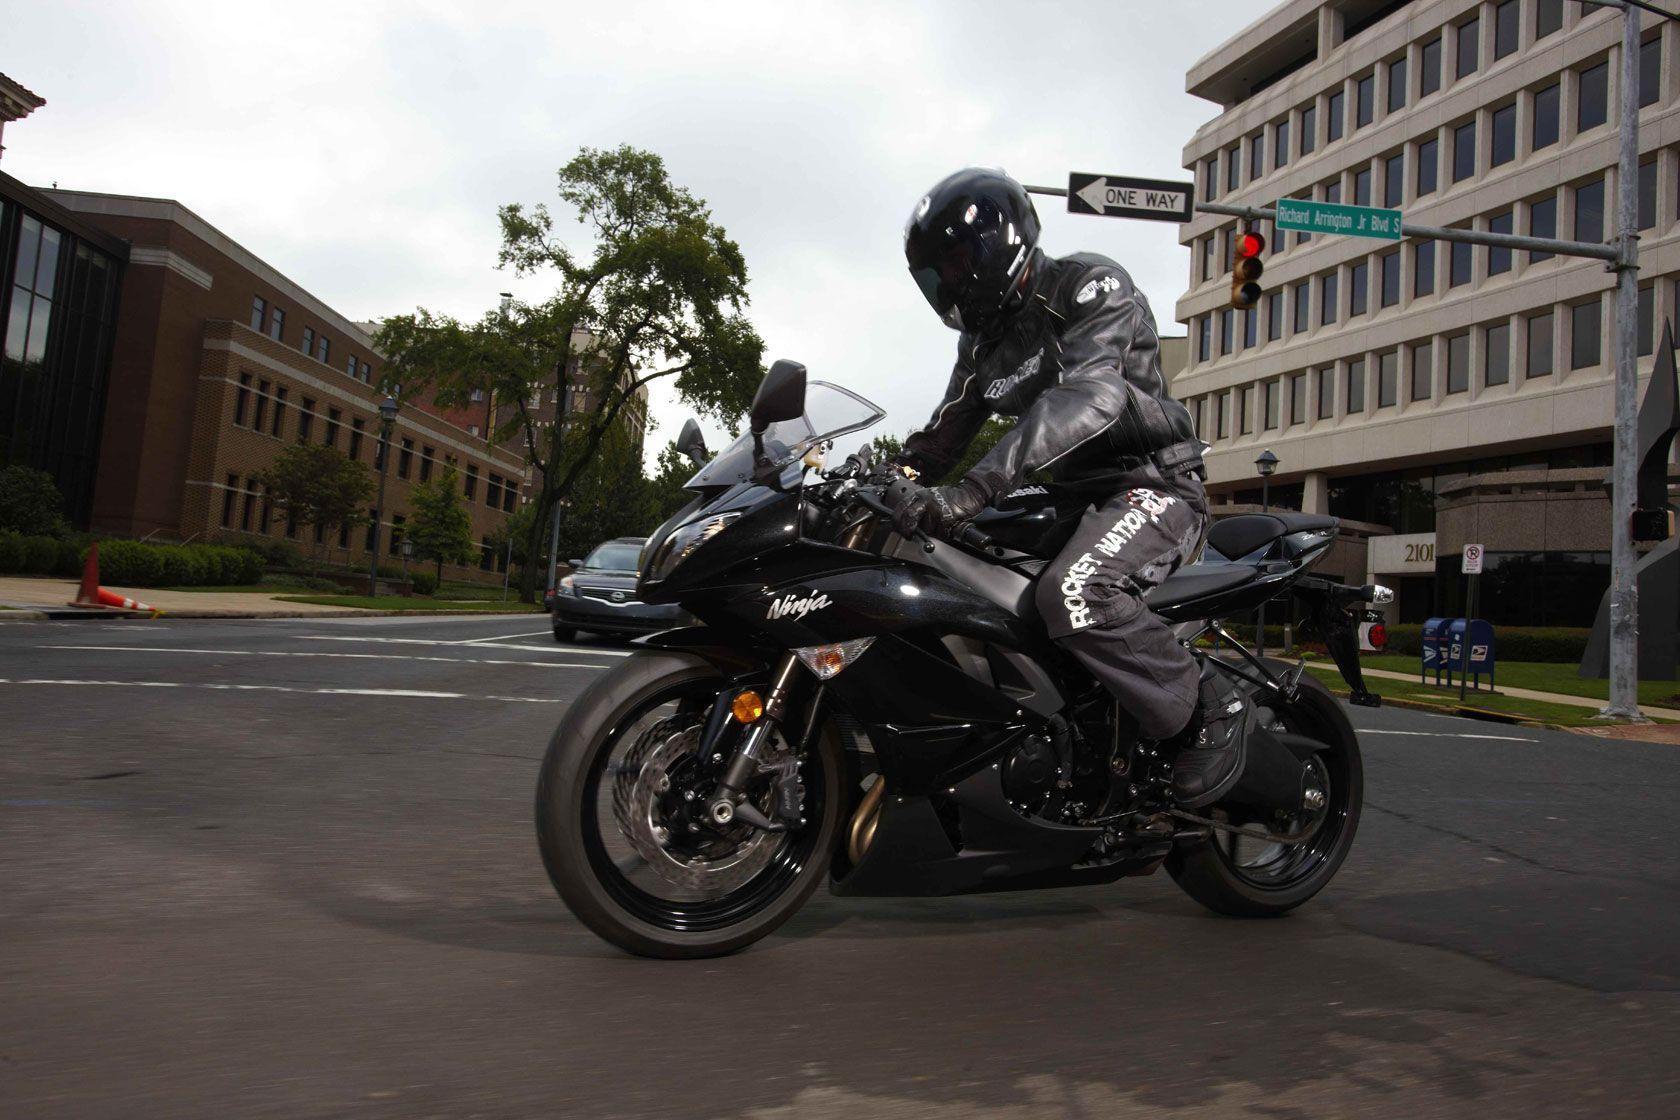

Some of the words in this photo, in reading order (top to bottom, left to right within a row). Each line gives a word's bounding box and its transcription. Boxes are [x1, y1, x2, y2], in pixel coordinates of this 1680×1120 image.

[1105, 188, 1137, 206] ONE
[1145, 192, 1179, 209] WAY
[1279, 206, 1310, 225] Richard
[1314, 209, 1353, 232] Arrington
[1357, 213, 1367, 230] Jr
[1371, 214, 1389, 233] Blvd
[1393, 217, 1400, 233] S
[1405, 544, 1434, 562] 2101
[1061, 553, 1102, 629] ROCKET
[1094, 508, 1148, 558] NATION
[766, 589, 833, 622] Ninja
